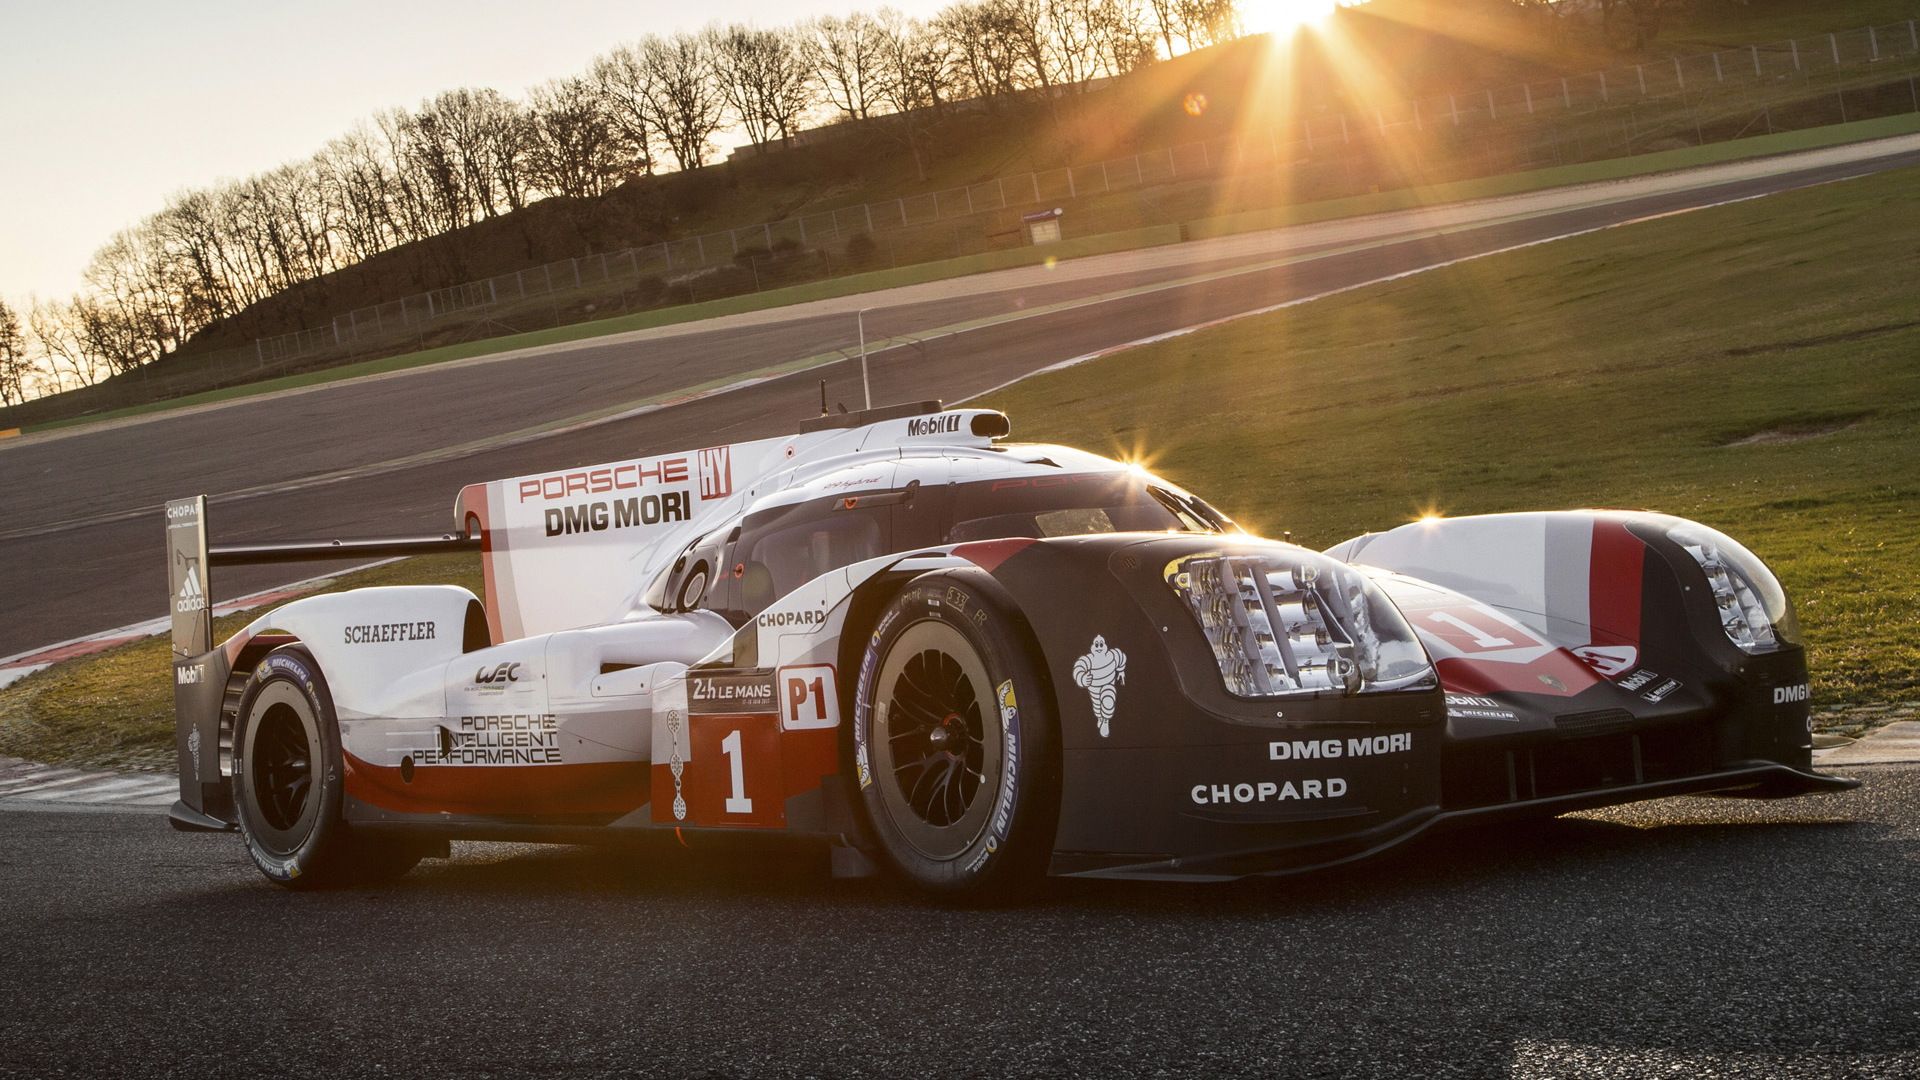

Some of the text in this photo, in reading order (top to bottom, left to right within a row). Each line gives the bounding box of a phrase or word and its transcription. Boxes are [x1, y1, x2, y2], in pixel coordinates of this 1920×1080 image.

[908, 415, 961, 436] Mobil 1
[519, 447, 731, 503] PORSCHE HY
[544, 490, 691, 537] DMG MORI
[177, 596, 206, 613] adidas
[759, 610, 825, 627] CHOPARD
[1427, 611, 1514, 648] 1
[344, 621, 435, 644] SCHAEFFLER
[271, 658, 306, 681] MICHELIN
[475, 662, 520, 683] WEC
[718, 686, 733, 698] LE
[735, 685, 771, 698] MANS
[788, 677, 827, 720] P1
[854, 649, 871, 742] MICHELIN
[1446, 696, 1479, 706] obil
[1773, 684, 1805, 704] DMG
[461, 714, 556, 731] PORSCHE
[1462, 710, 1514, 719] MICHELIN
[437, 731, 557, 748] INTELLIGENT
[1269, 733, 1412, 760] DMG MORI
[412, 748, 562, 764] PERFORMANCE
[722, 730, 753, 813] 1
[996, 733, 1017, 834] MICHELIN
[1191, 778, 1347, 804] CHOPARD
